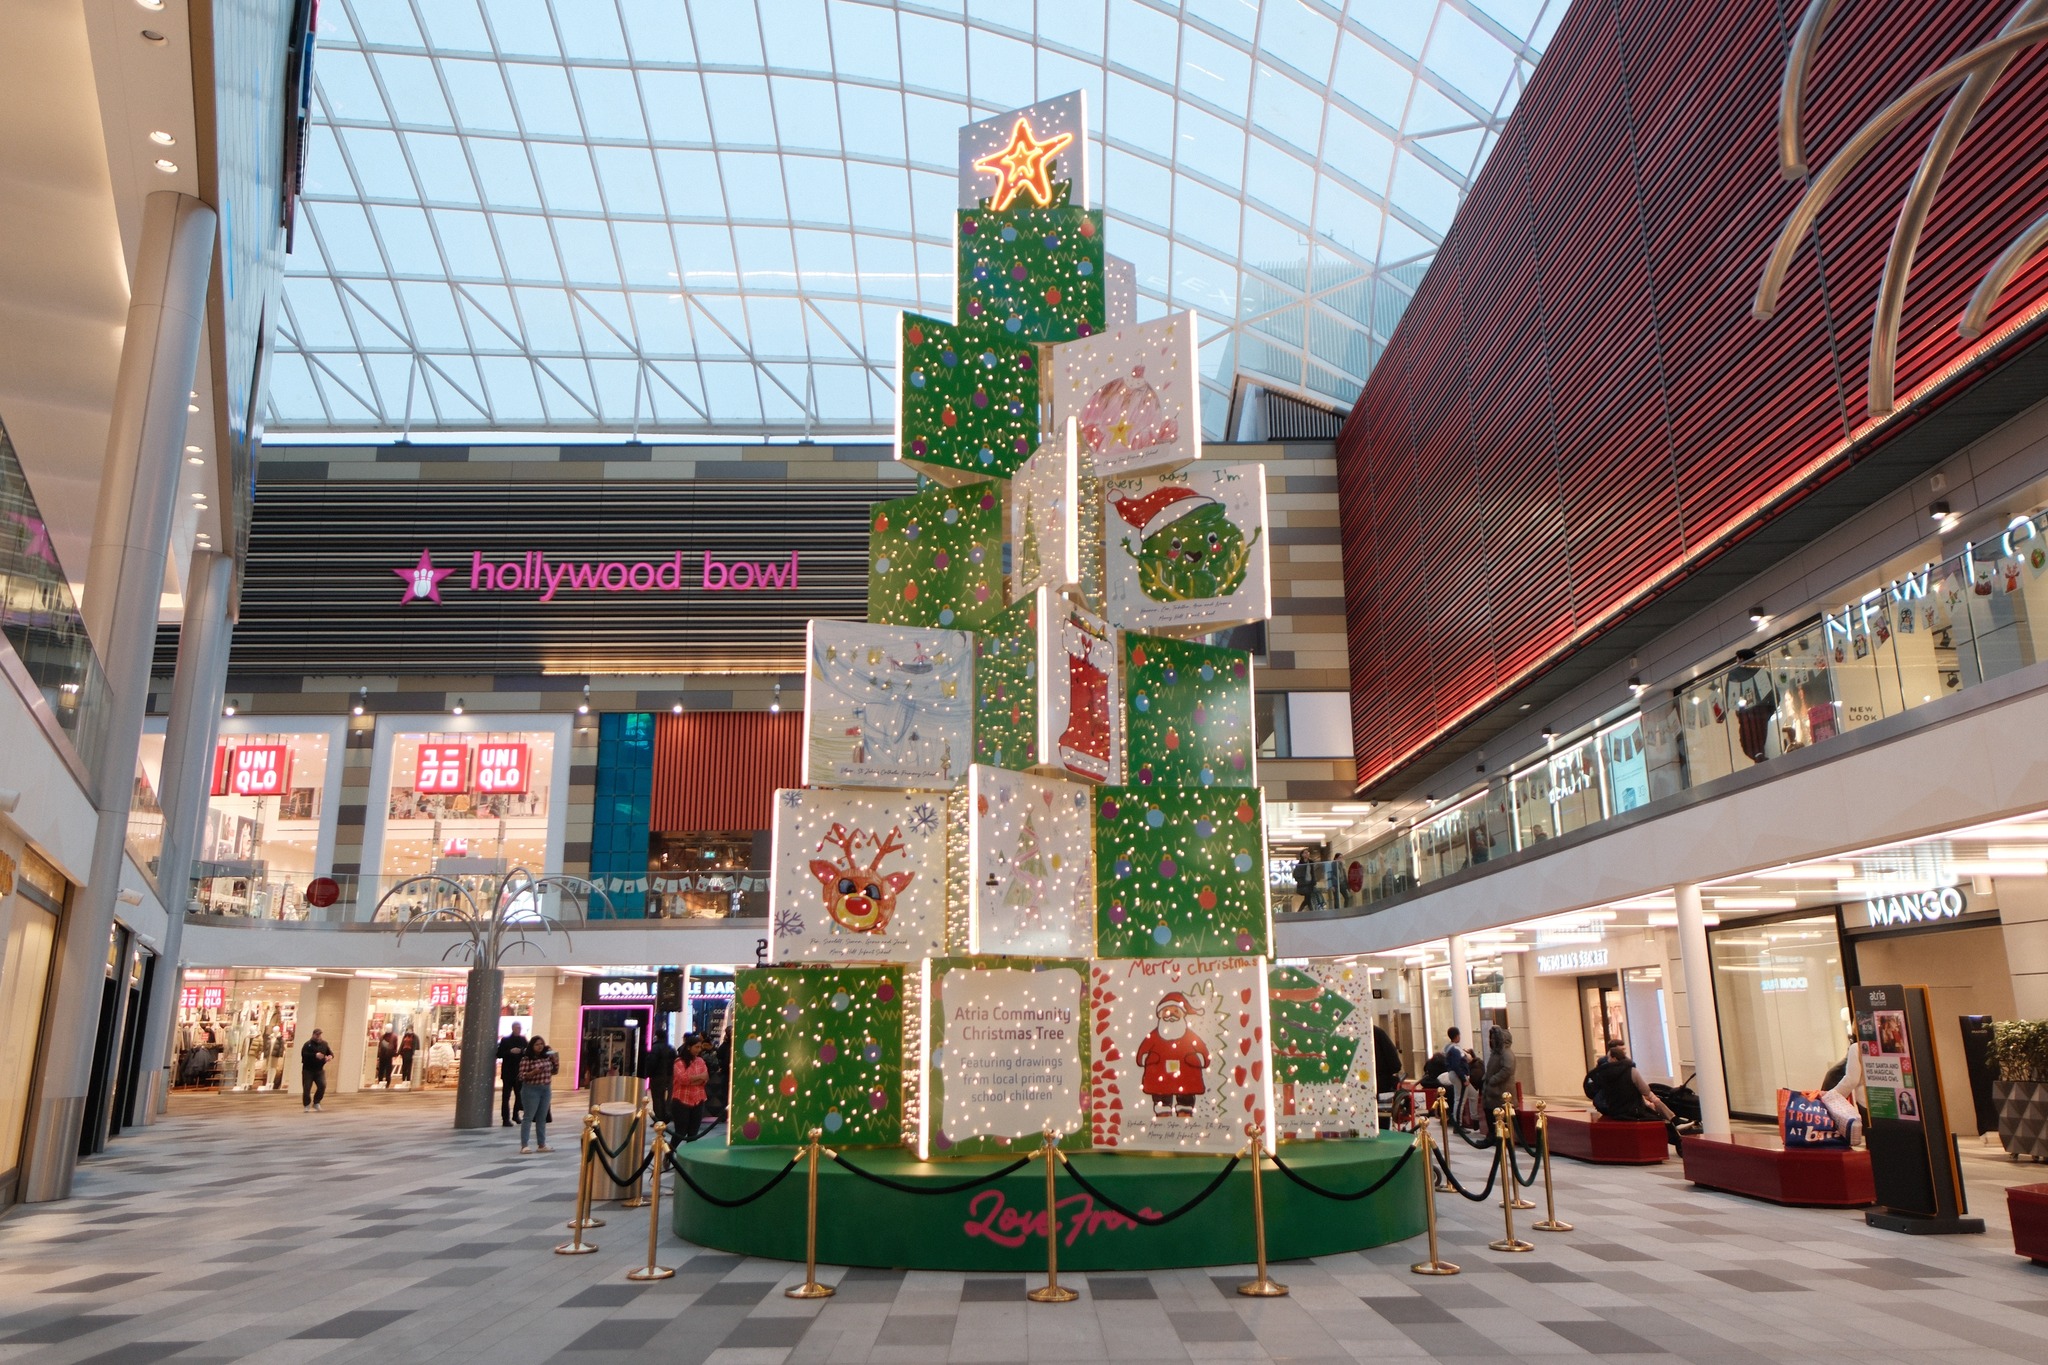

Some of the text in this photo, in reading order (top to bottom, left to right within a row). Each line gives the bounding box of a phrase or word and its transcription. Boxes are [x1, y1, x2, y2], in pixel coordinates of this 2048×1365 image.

[1106, 477, 1143, 490] every
[1212, 469, 1241, 483] I'm
[470, 549, 799, 602] hollywood bowl
[239, 750, 275, 768] UNI
[422, 749, 460, 767] ユニ
[481, 748, 518, 767] UNI
[236, 769, 277, 790] QLO
[419, 769, 458, 788] クロ
[479, 768, 520, 789] QLO
[1270, 860, 1299, 872] EXT
[1867, 887, 1963, 928] MANGO
[1128, 958, 1180, 983] Merry
[205, 988, 222, 997] UNI
[599, 982, 648, 996] BOOM
[704, 981, 735, 995] BAR
[1869, 990, 1886, 1001] atria
[204, 997, 222, 1007] QLO
[954, 1006, 1071, 1025] Atria Community
[962, 1026, 1064, 1041] Christmas Tree
[960, 1056, 1063, 1070] Featuring drawings
[963, 1073, 1063, 1087] from local primary
[971, 1090, 1053, 1103] school children
[1789, 1100, 1829, 1115] I CAN'T
[1789, 1127, 1803, 1136] AT
[963, 1188, 1063, 1248] Love
